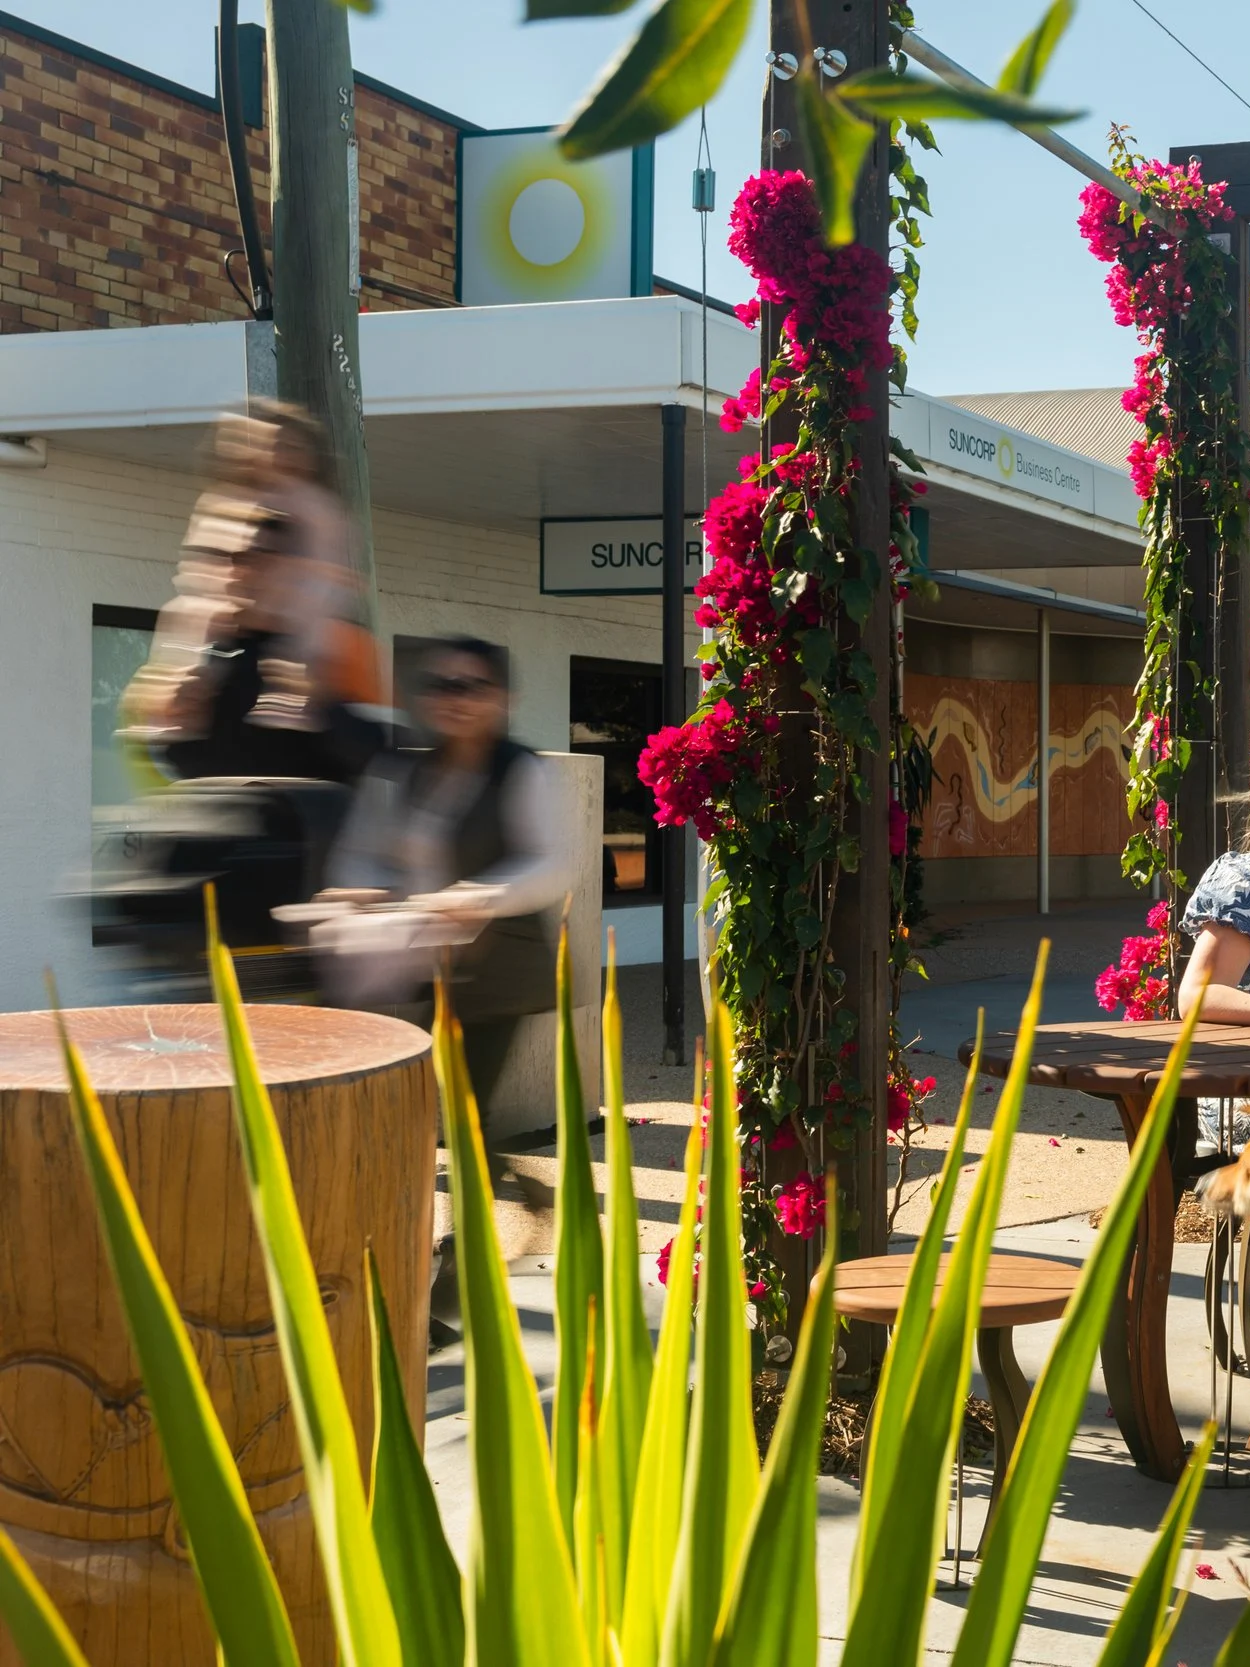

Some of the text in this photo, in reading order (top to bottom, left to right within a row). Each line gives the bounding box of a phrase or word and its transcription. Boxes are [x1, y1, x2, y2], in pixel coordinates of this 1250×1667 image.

[949, 428, 1081, 493] SUNCORP Business Centre
[591, 541, 704, 568] SUNCR
